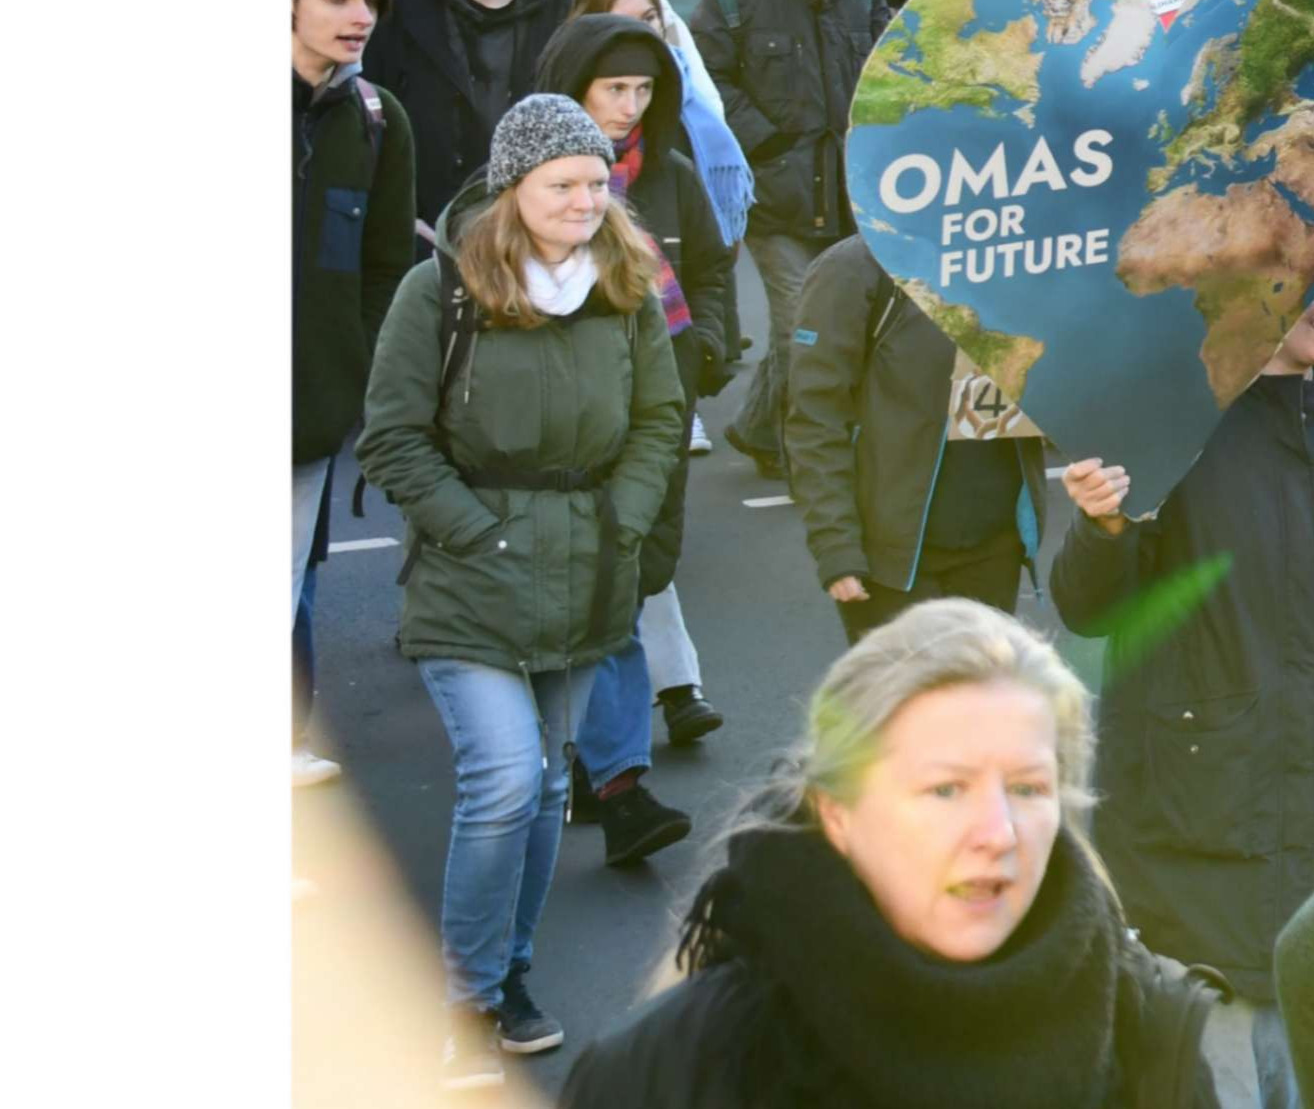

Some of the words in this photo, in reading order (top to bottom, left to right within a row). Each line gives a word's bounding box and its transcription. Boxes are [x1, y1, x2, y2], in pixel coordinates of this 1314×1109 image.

[879, 128, 1114, 214] OMAS
[941, 204, 1025, 246] FOR
[940, 228, 1110, 288] FUTURE
